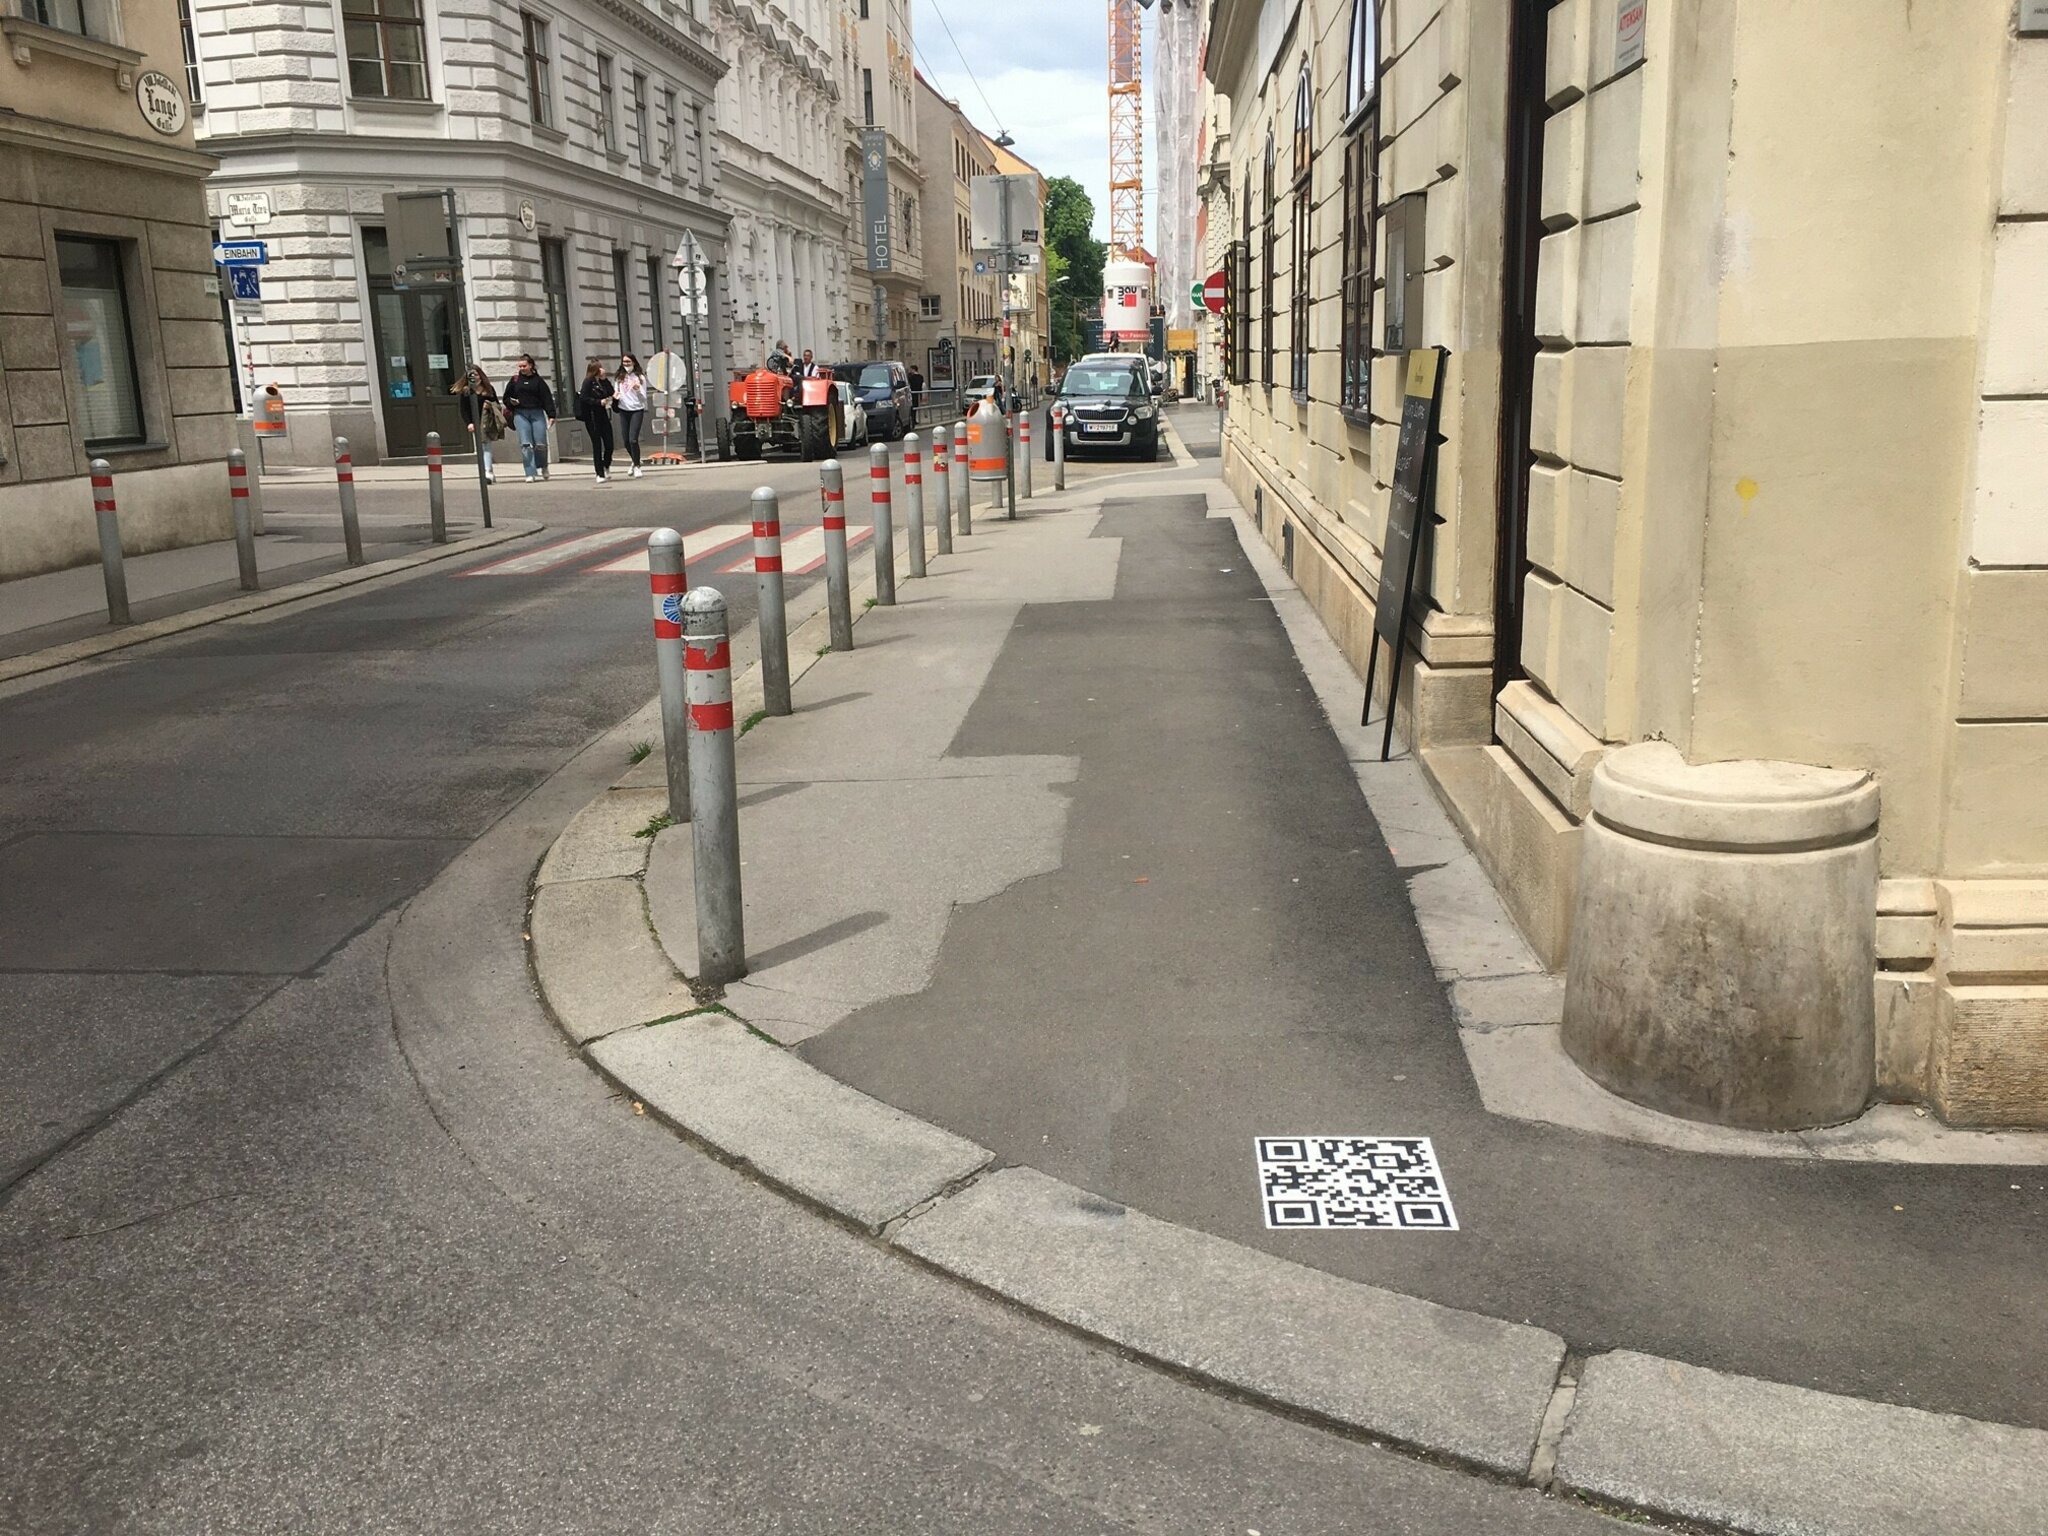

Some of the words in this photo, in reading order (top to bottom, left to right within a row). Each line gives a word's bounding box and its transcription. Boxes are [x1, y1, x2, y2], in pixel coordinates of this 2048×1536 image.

[145, 87, 177, 121] Lange
[224, 248, 258, 259] EINBAHN
[874, 215, 888, 269] HOTEL
